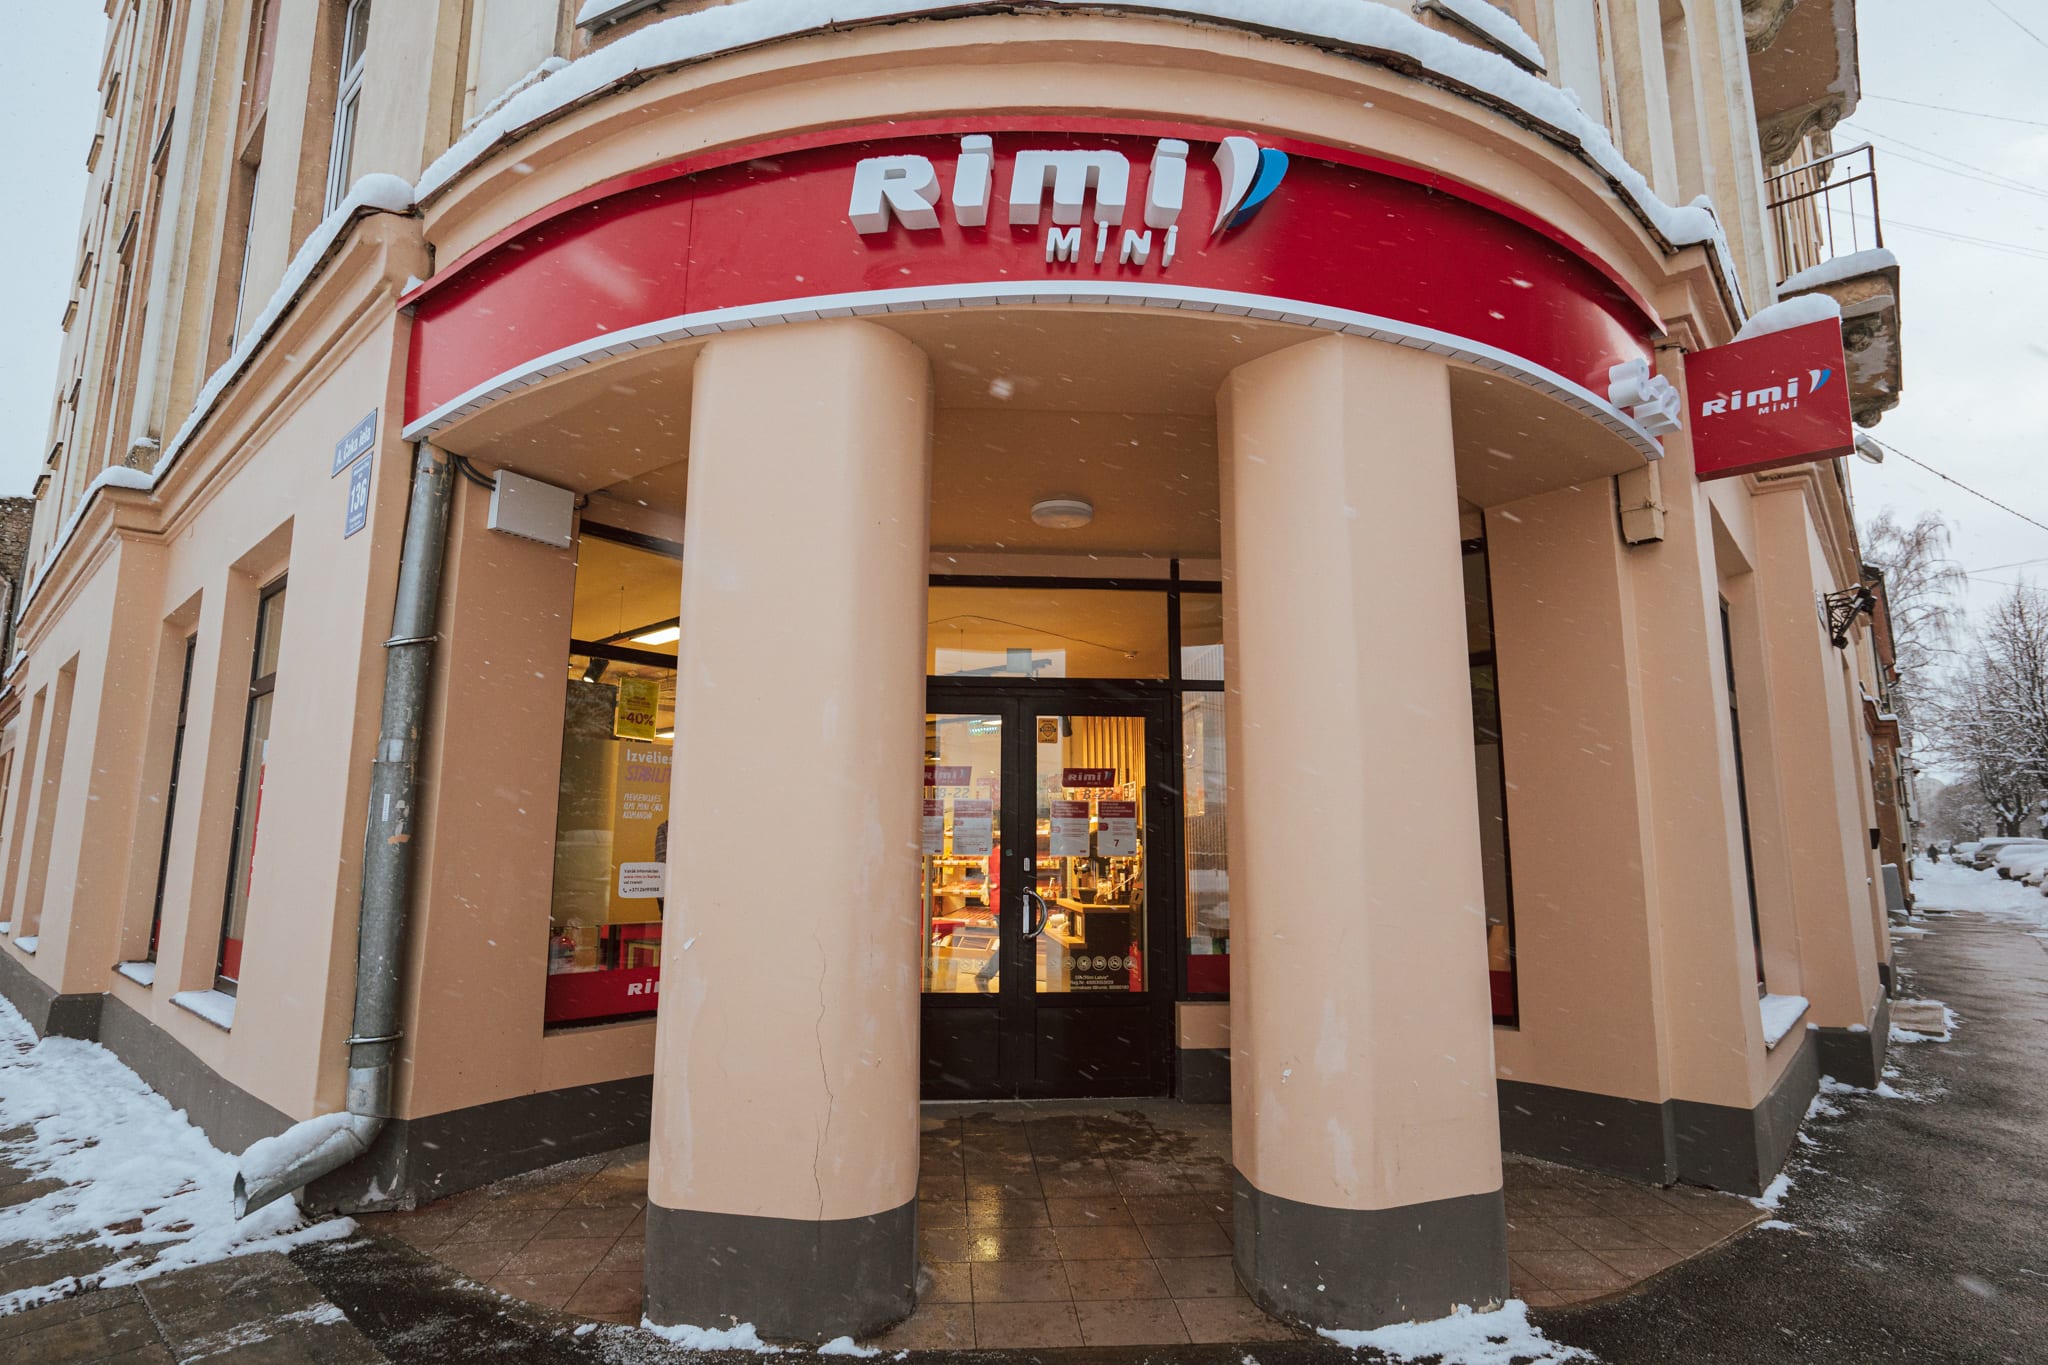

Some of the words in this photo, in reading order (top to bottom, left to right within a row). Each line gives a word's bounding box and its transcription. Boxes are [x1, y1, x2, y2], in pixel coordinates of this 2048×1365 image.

[848, 134, 1189, 235] Rimi
[1702, 377, 1799, 417] Rimi
[350, 478, 367, 513] 136
[620, 712, 654, 727] -40%
